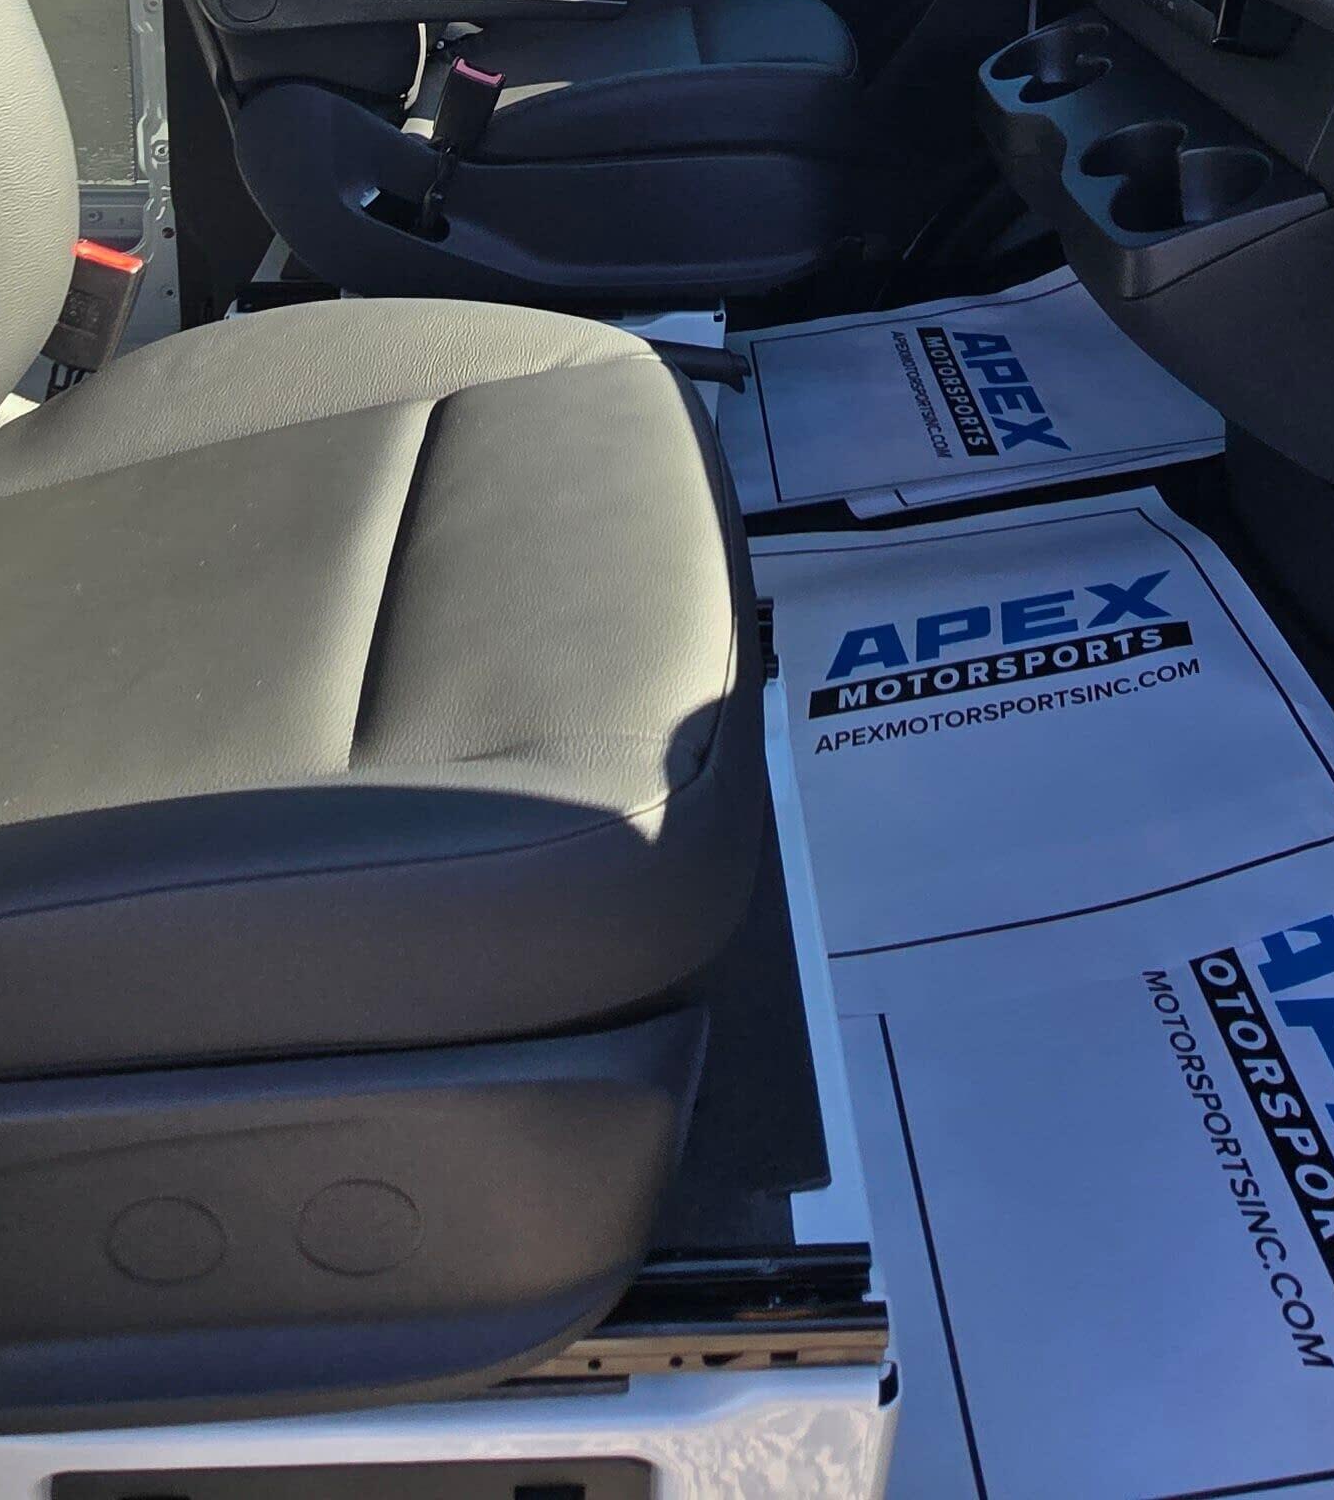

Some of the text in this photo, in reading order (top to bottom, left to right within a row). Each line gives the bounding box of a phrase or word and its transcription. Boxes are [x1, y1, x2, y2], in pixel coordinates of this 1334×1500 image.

[890, 330, 953, 459] APEXMOTORSPORTSINC.COM
[925, 336, 988, 447] MOTORSPORTS
[953, 332, 1071, 451] APEX
[825, 570, 1172, 681] APEX
[838, 628, 1164, 709] MOTORSPORTS
[814, 658, 1201, 755] APEXMOTORSPORTSINC.COM
